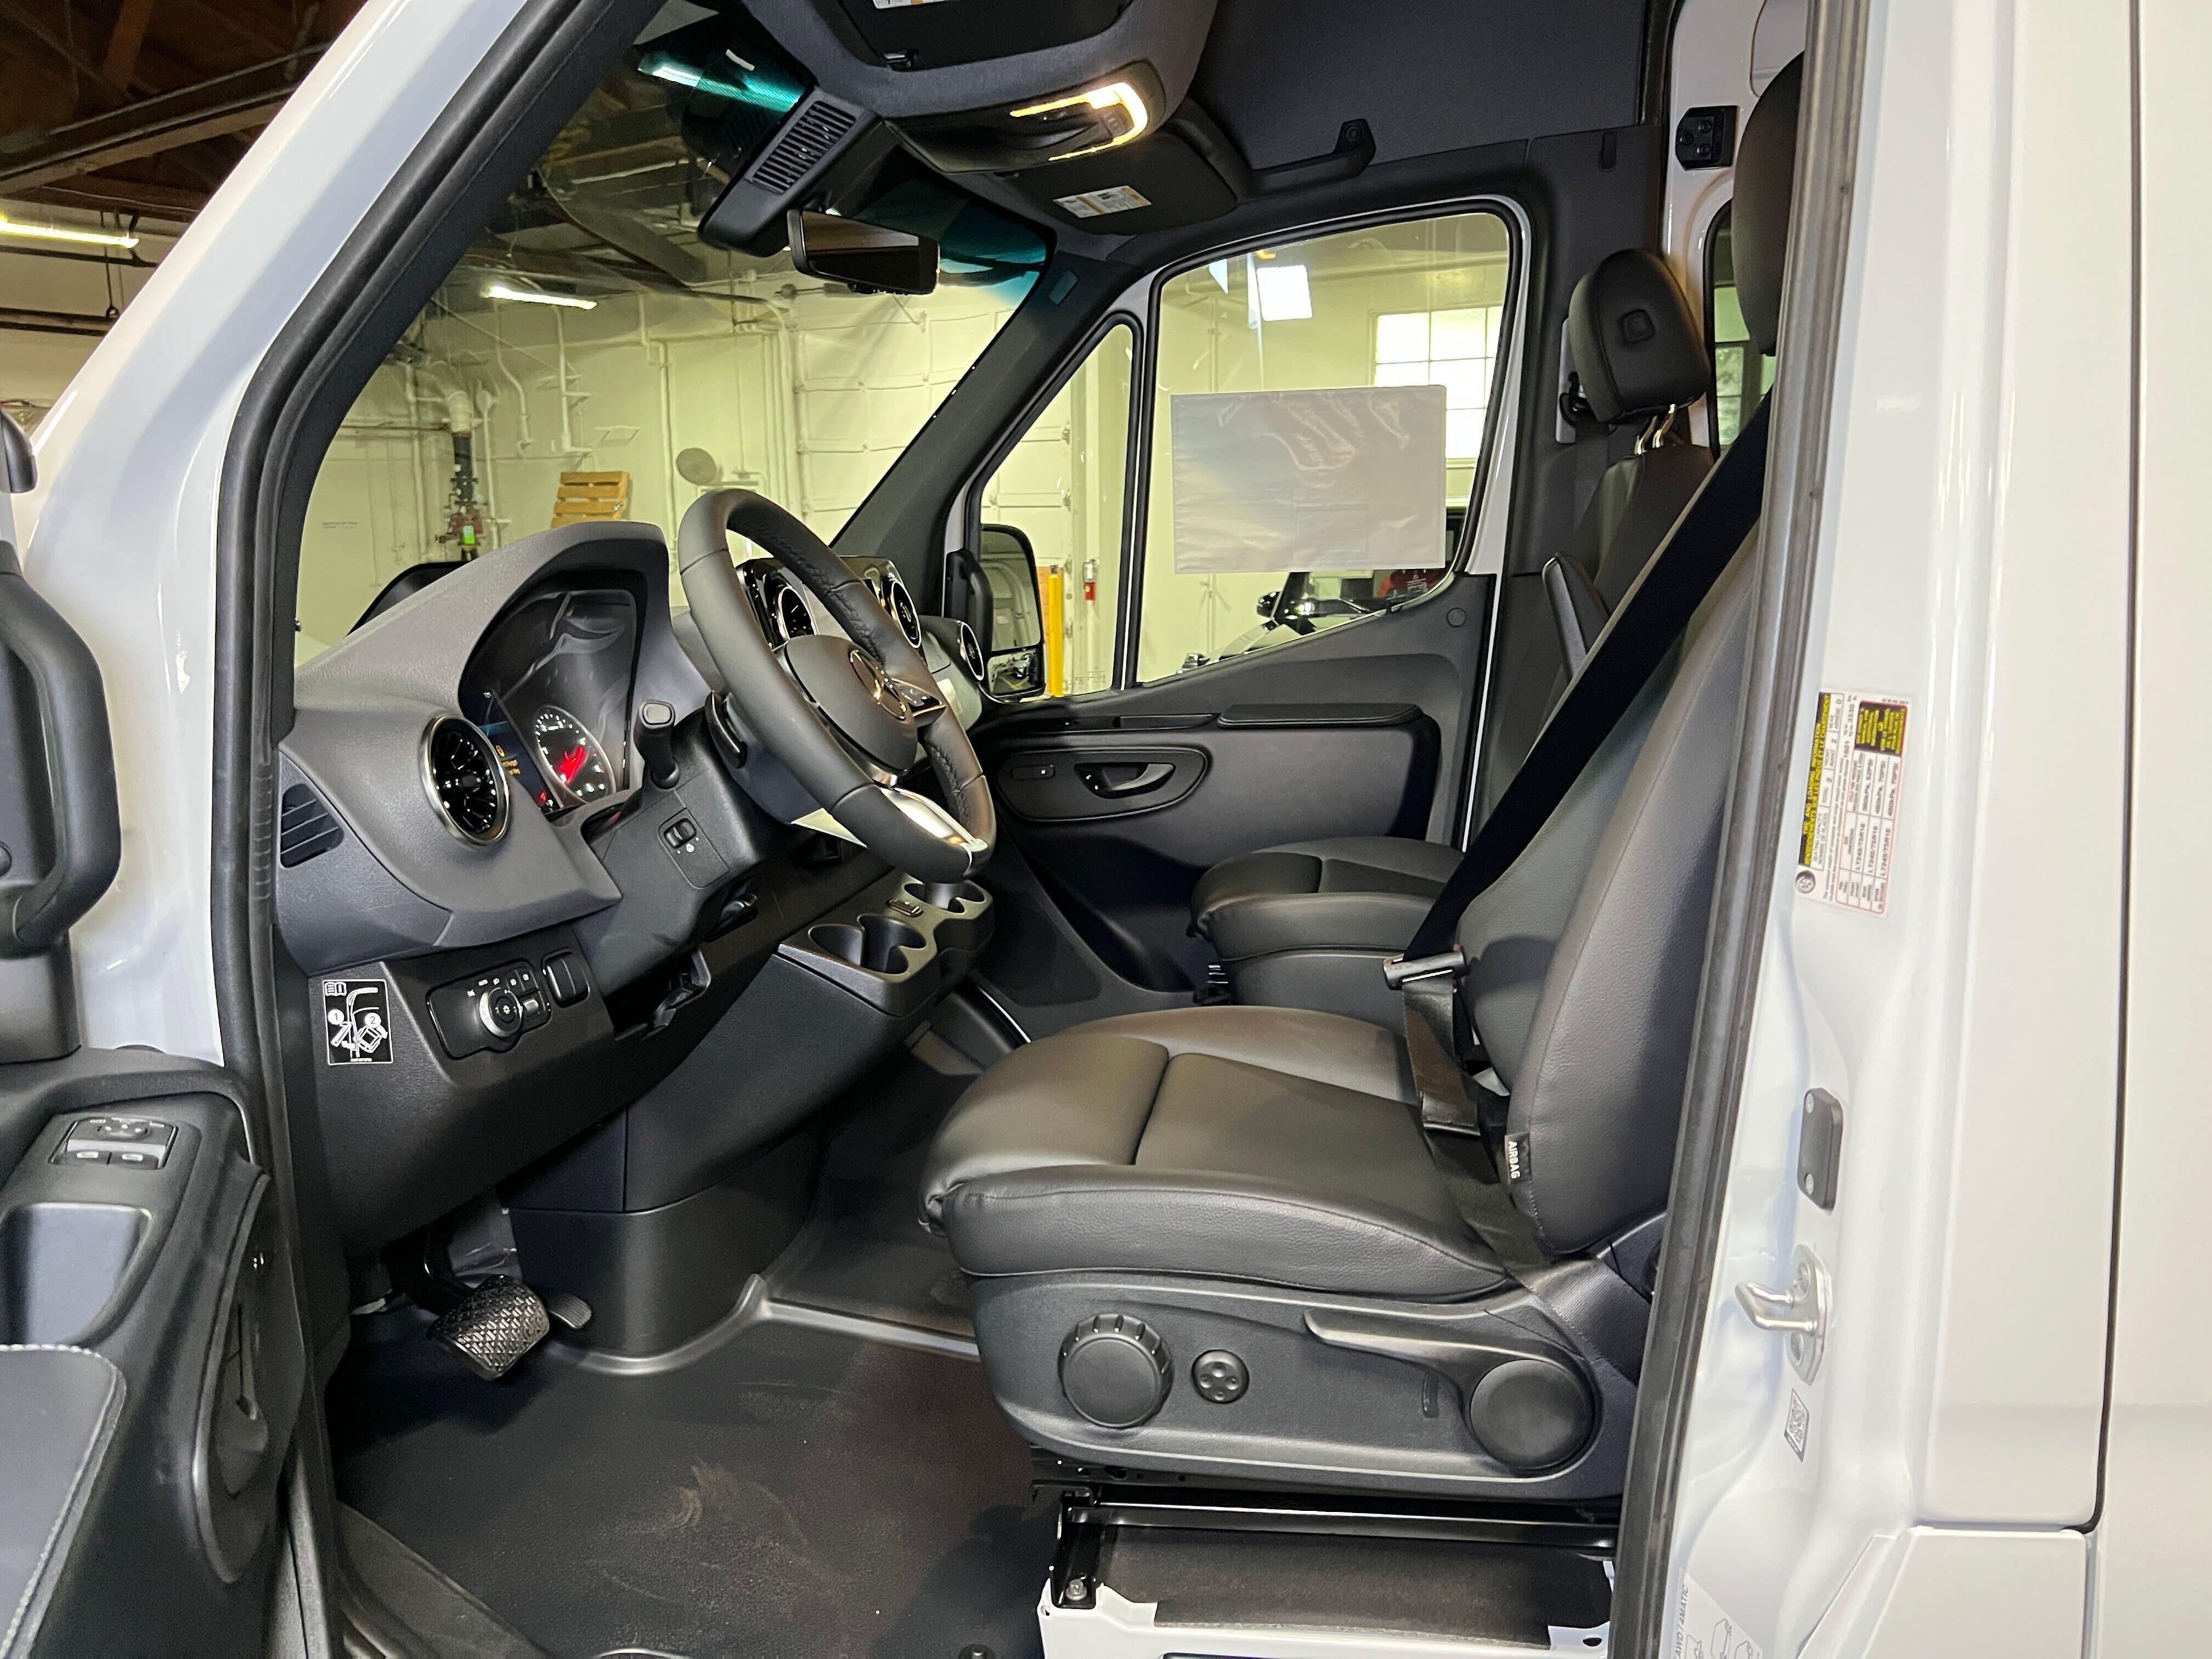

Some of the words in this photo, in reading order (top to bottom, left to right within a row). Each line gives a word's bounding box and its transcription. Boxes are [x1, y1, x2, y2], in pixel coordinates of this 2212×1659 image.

[1811, 723, 1821, 766] INFORMATION
[1855, 822, 1865, 870] LT245/75R16
[1867, 825, 1878, 873] LT245/75R16
[1880, 827, 1891, 876] LT245/75R16
[1508, 1141, 1520, 1179] AIRBAG
